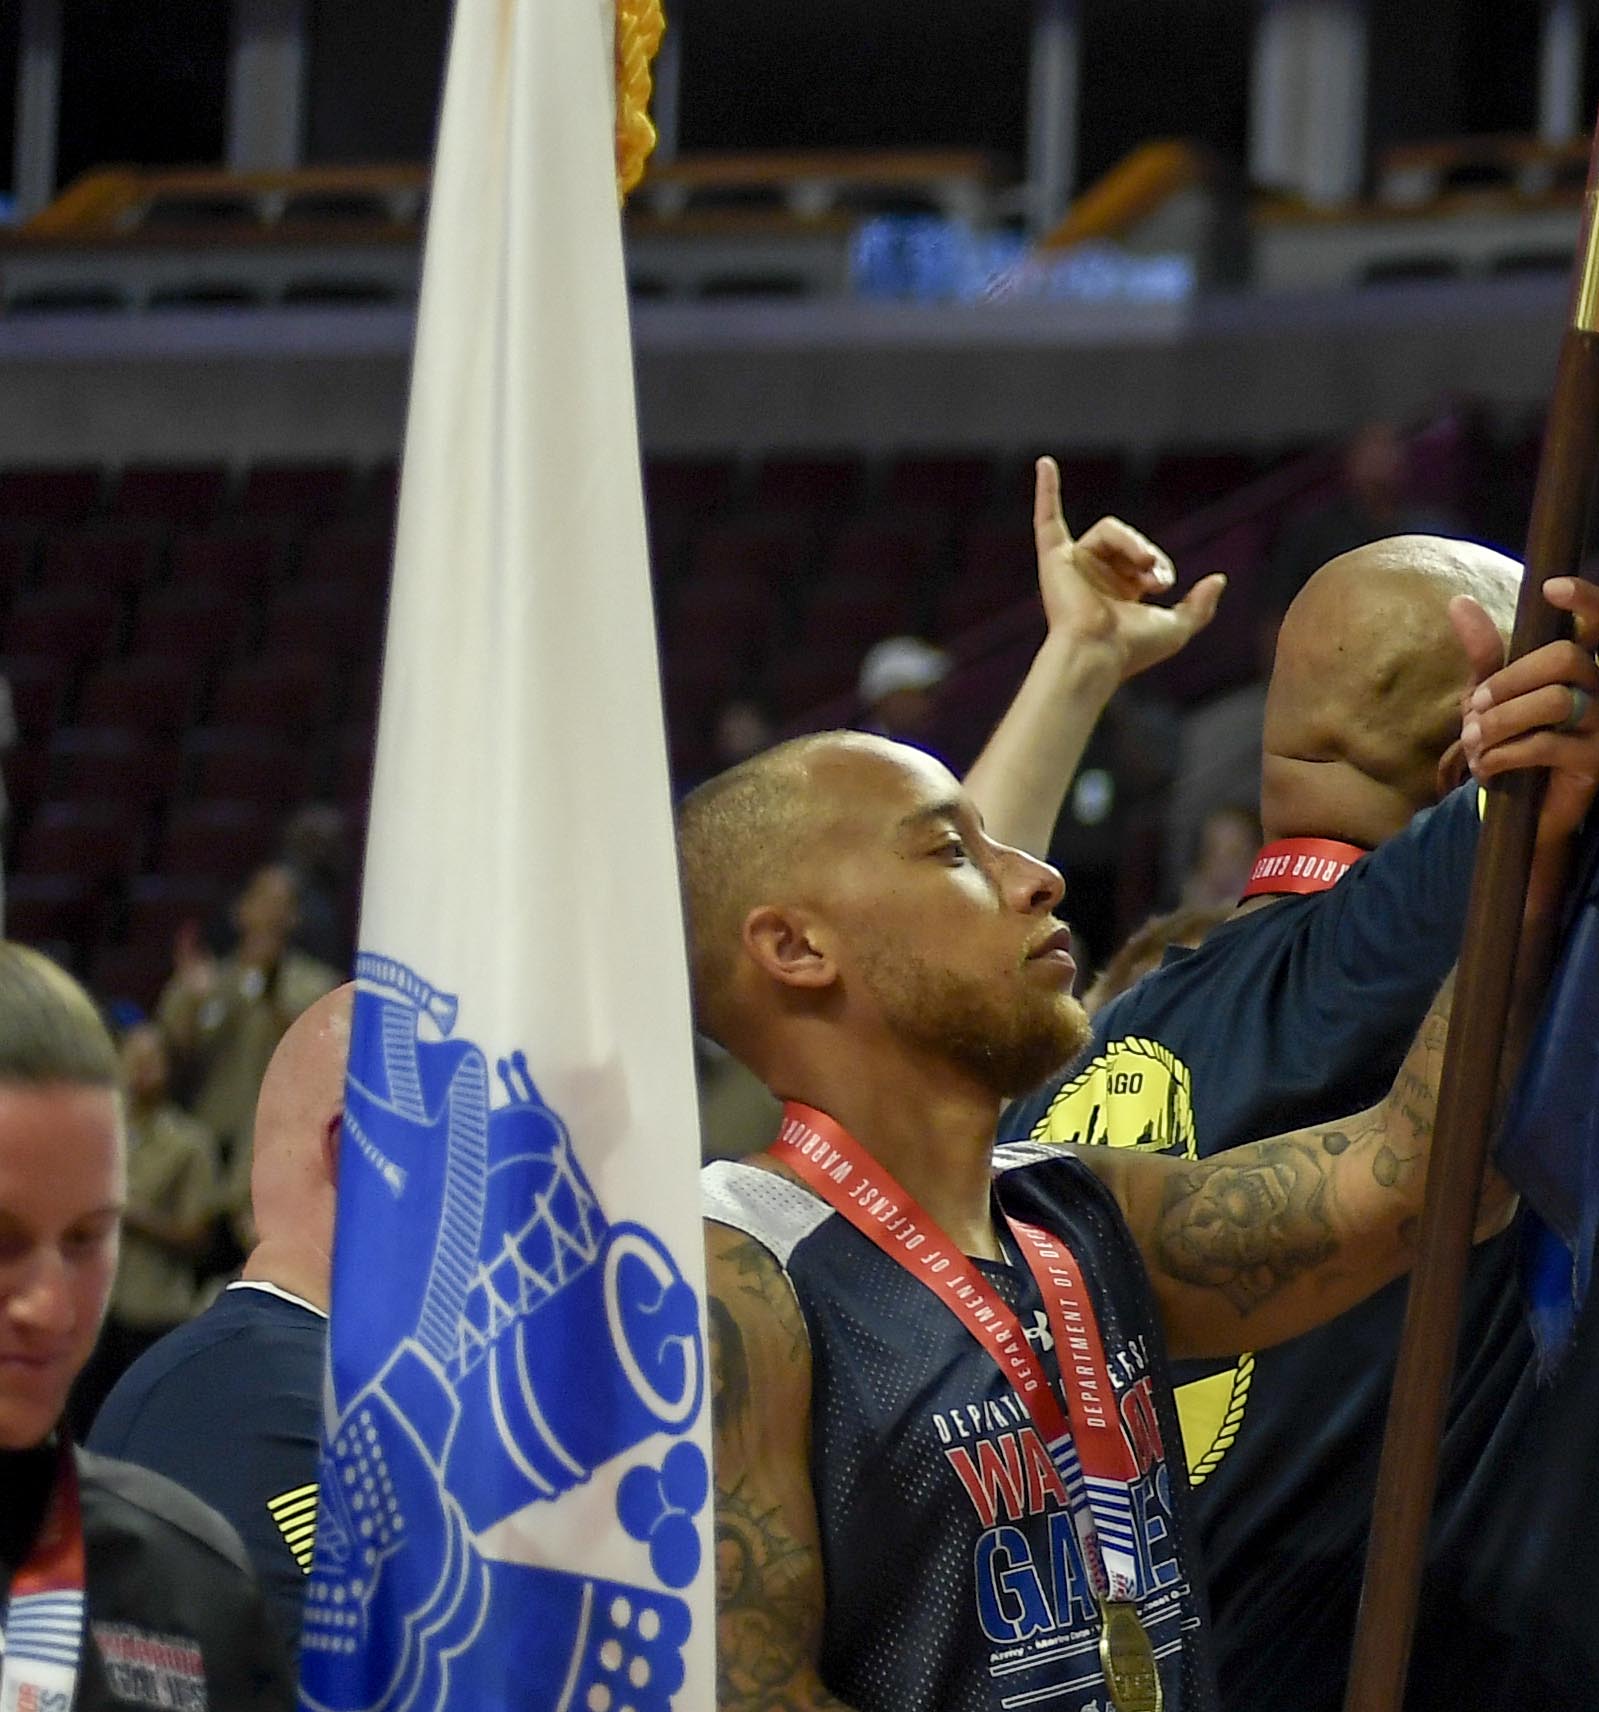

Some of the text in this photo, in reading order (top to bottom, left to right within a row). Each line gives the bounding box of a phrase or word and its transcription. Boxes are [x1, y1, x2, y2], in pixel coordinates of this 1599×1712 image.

[848, 1178, 926, 1251] DEFENSE
[920, 1250, 951, 1274] OF
[1049, 1266, 1073, 1288] OF
[946, 1275, 1039, 1392] DEPARTMENT
[1059, 1298, 1107, 1428] DEPARTMENT
[989, 1646, 1025, 1664] Army
